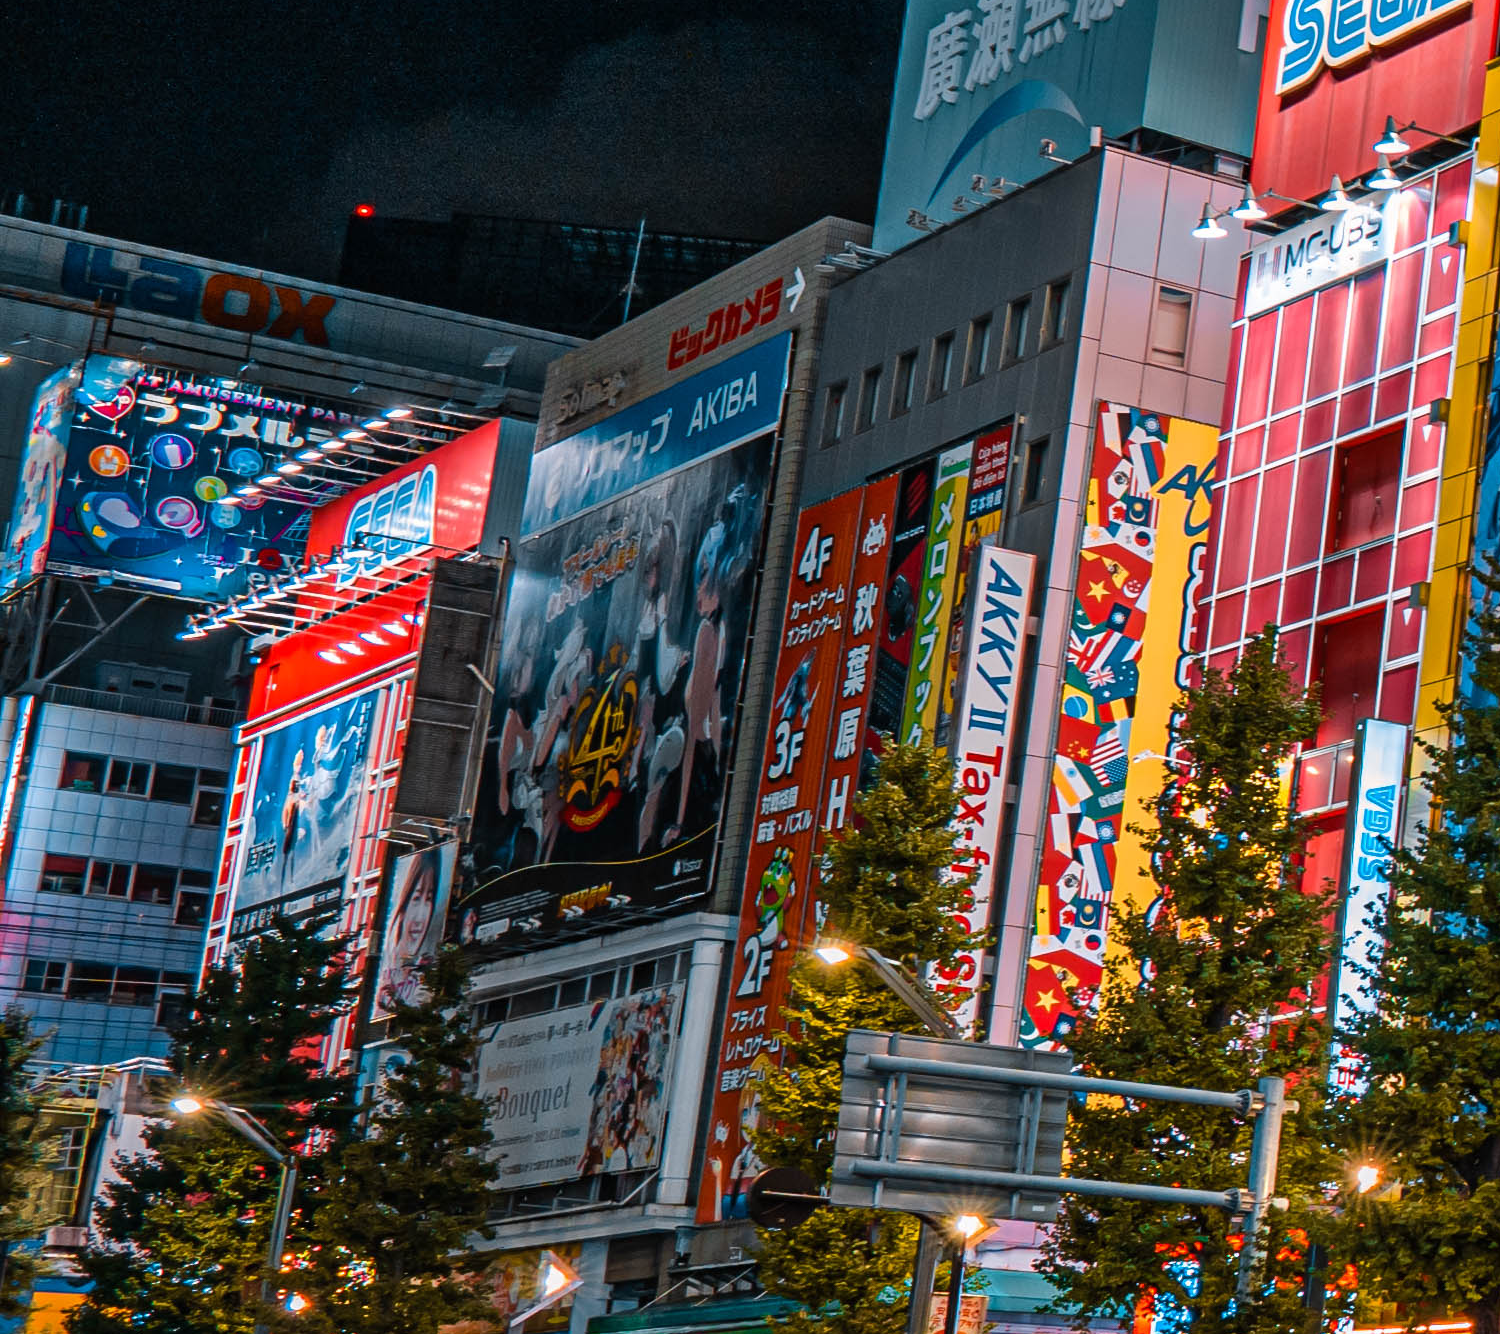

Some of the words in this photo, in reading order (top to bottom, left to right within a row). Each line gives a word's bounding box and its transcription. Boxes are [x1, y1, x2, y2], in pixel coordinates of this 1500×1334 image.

[668, 278, 783, 371] ビックカメラ
[687, 371, 758, 437] AKIBA
[798, 527, 834, 583] 4F
[785, 611, 842, 648] オンラインゲーム
[790, 582, 845, 621] カードゲーム
[977, 557, 1022, 707] AKKY
[768, 718, 804, 782] 3F
[1357, 784, 1397, 884] SEGA
[735, 936, 774, 998] 2F
[725, 1035, 780, 1063] レトロゲーム
